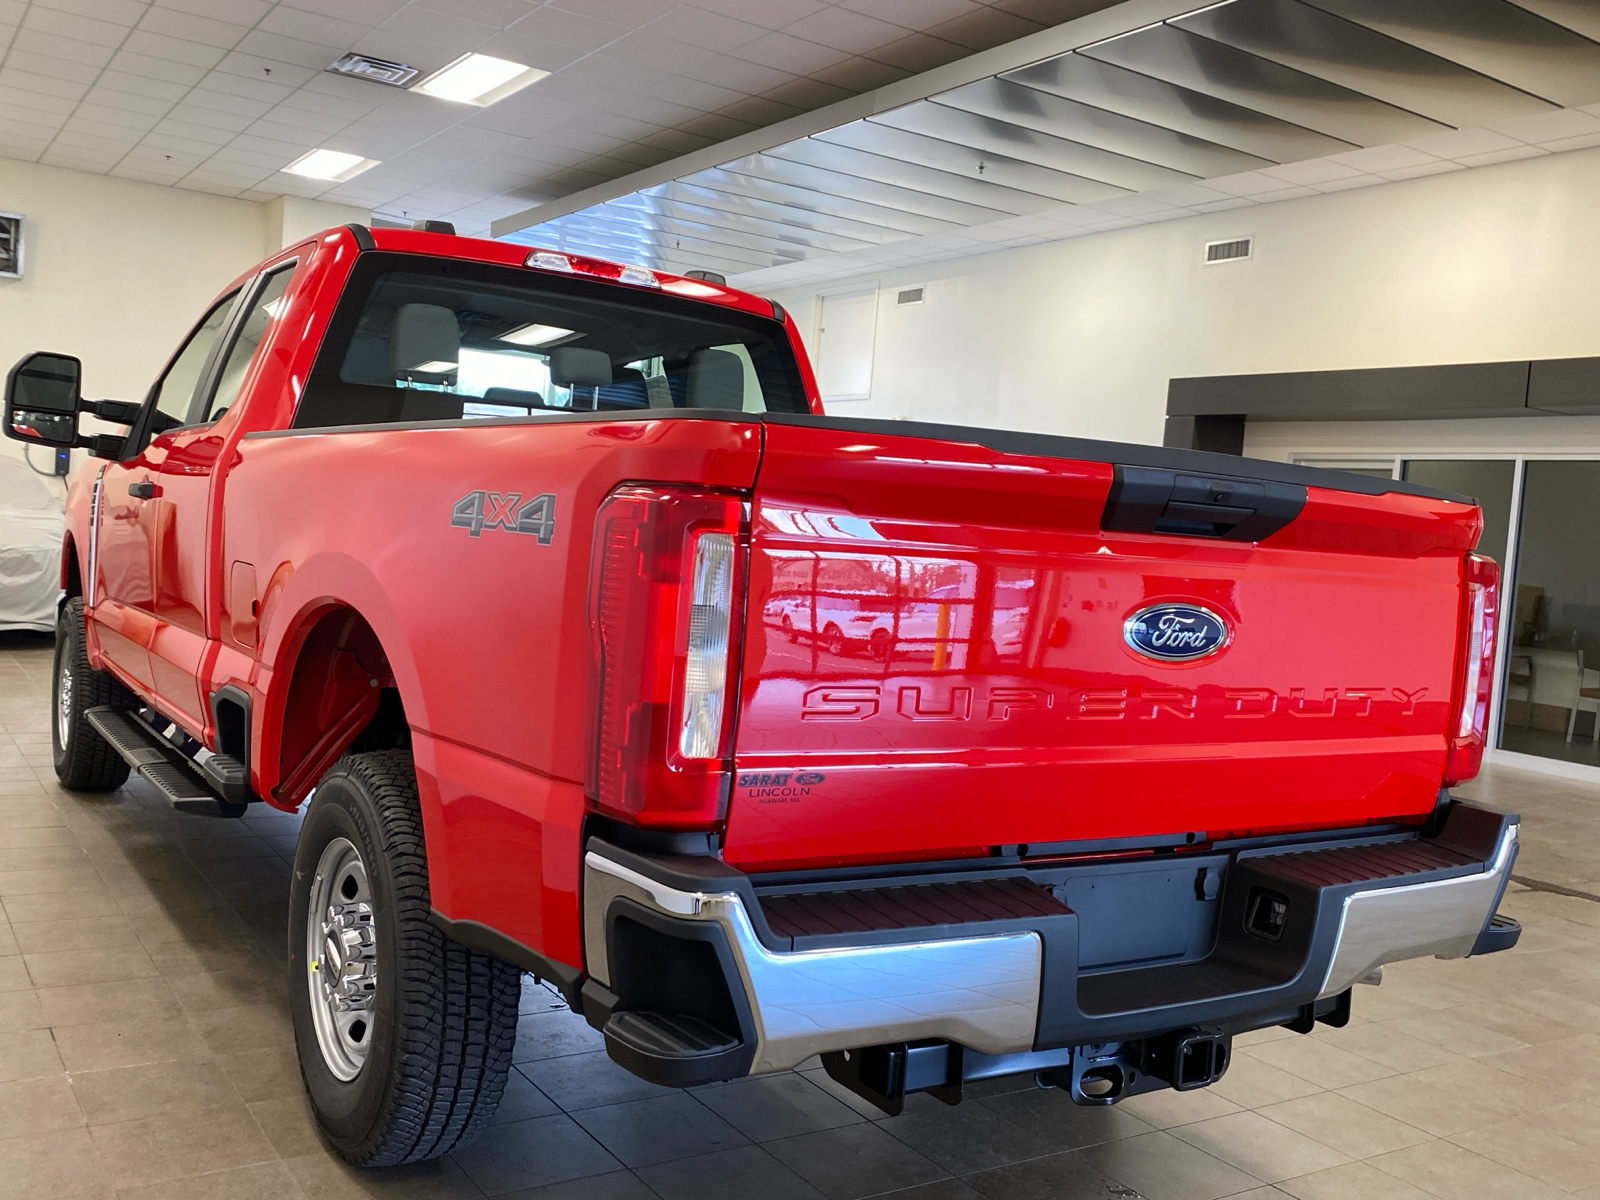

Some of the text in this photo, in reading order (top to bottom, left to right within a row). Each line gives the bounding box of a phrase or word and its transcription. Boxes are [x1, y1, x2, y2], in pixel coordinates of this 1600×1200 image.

[1151, 612, 1208, 648] Ford
[800, 684, 1429, 722] SUPER DUTY
[737, 773, 793, 787] SARAT
[748, 787, 811, 797] LINCOLN
